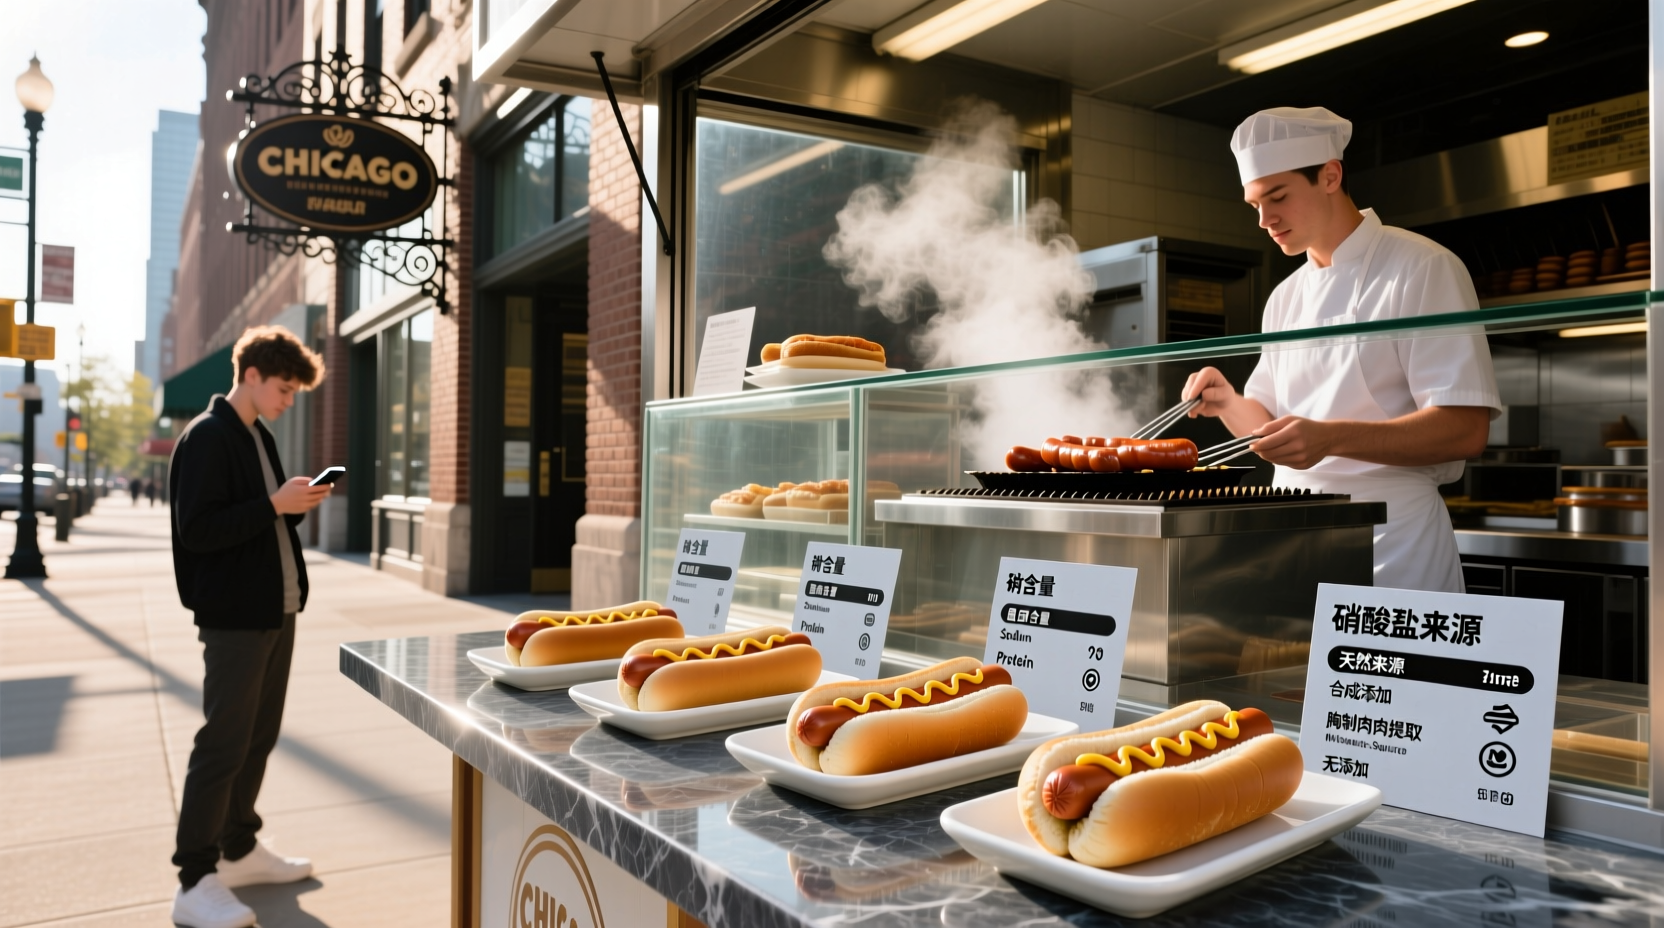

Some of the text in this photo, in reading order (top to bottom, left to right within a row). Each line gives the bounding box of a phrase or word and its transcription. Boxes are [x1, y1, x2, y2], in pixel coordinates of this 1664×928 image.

[258, 146, 418, 190] CHICAGO
[1332, 603, 1484, 646] 硝酸盐来源
[1339, 651, 1405, 675] 天然来源
[520, 882, 578, 928] CHI
